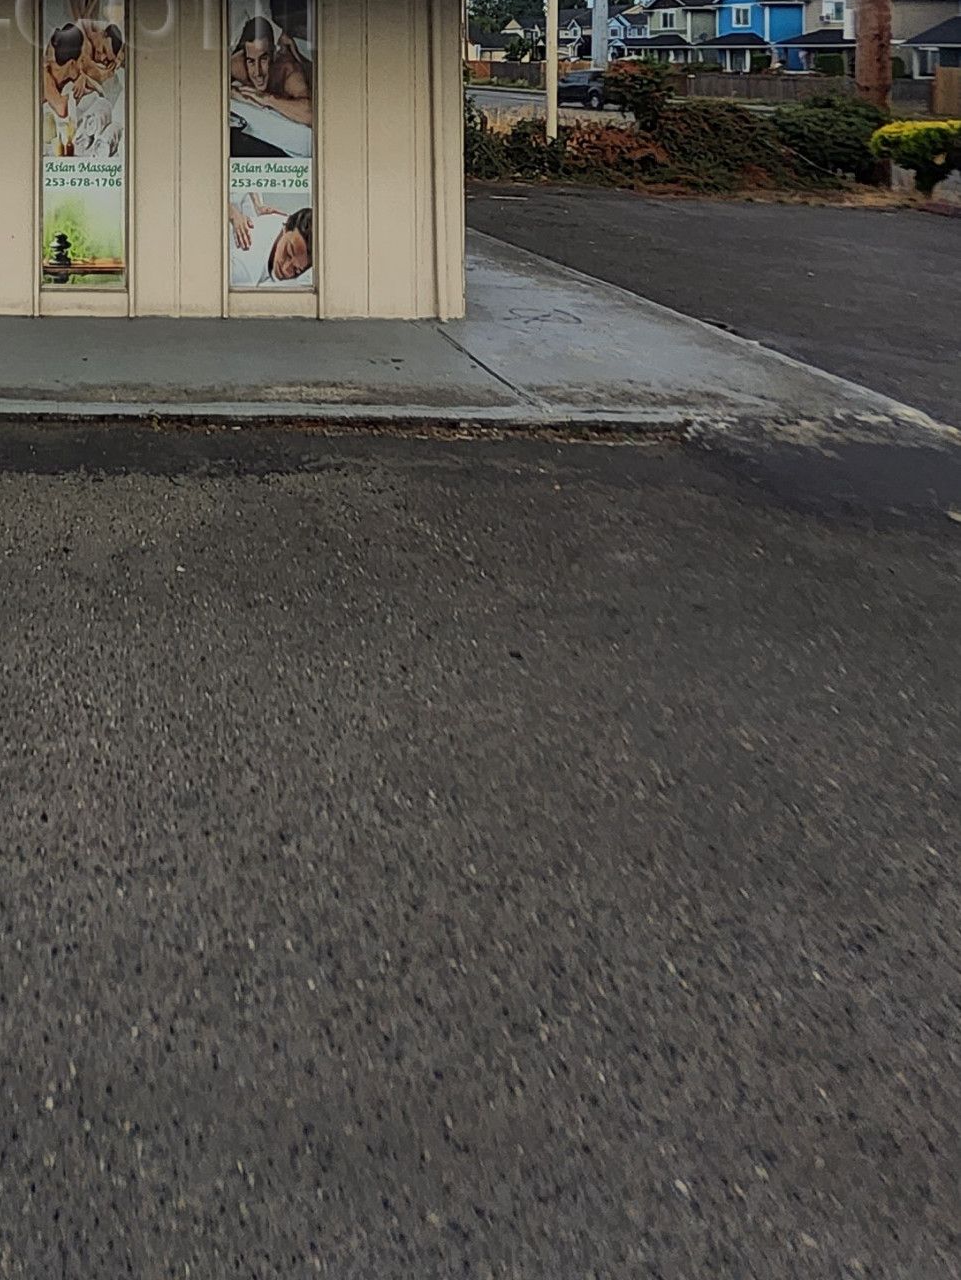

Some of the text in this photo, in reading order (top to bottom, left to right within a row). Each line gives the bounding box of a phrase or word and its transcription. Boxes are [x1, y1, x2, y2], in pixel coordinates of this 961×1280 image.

[45, 161, 122, 177] Asian Massage
[231, 162, 308, 178] Asian Massage
[45, 177, 122, 187] 253-678-1706
[231, 178, 309, 188] 253-678-1706
